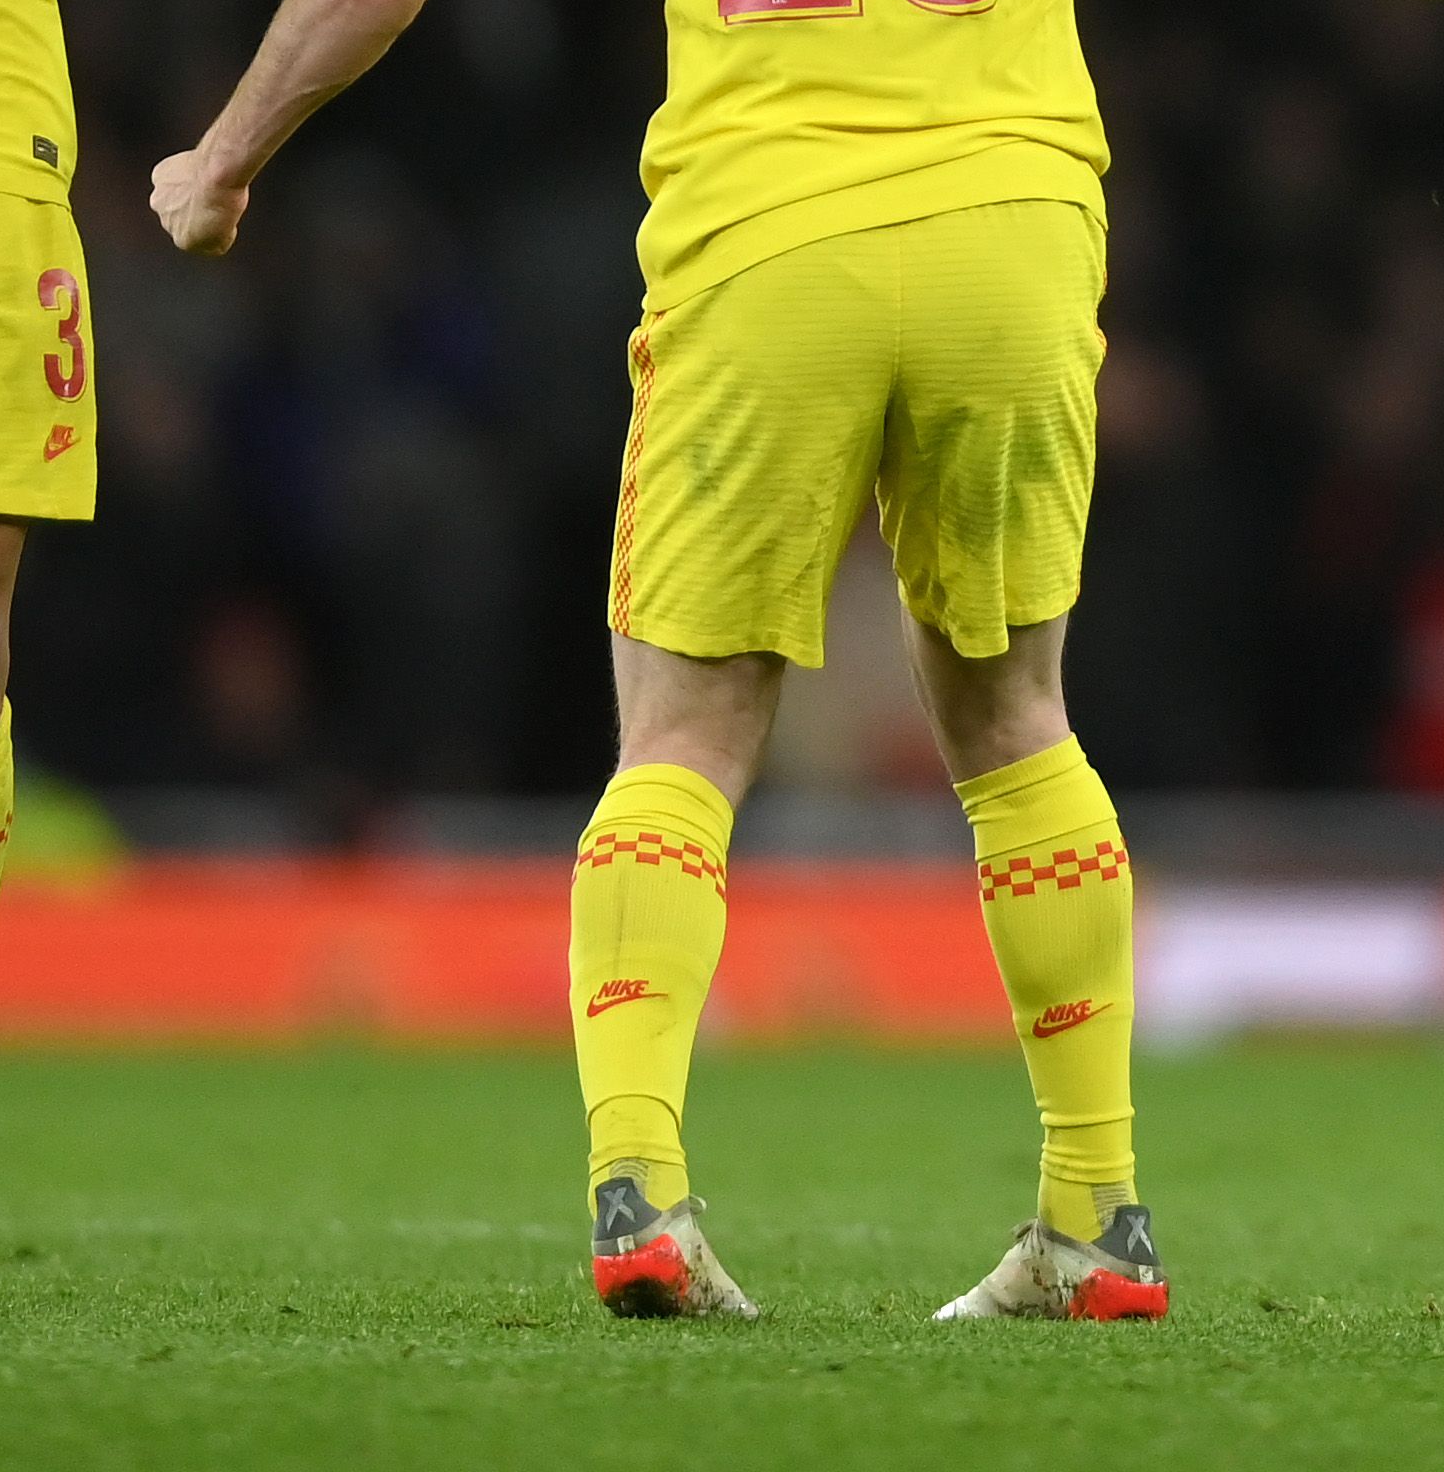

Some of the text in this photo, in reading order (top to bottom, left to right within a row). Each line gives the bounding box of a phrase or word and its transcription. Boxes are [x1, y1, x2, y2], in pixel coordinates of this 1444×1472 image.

[37, 267, 87, 404] 3
[597, 980, 650, 999] NIKE
[1042, 998, 1093, 1024] NIKE
